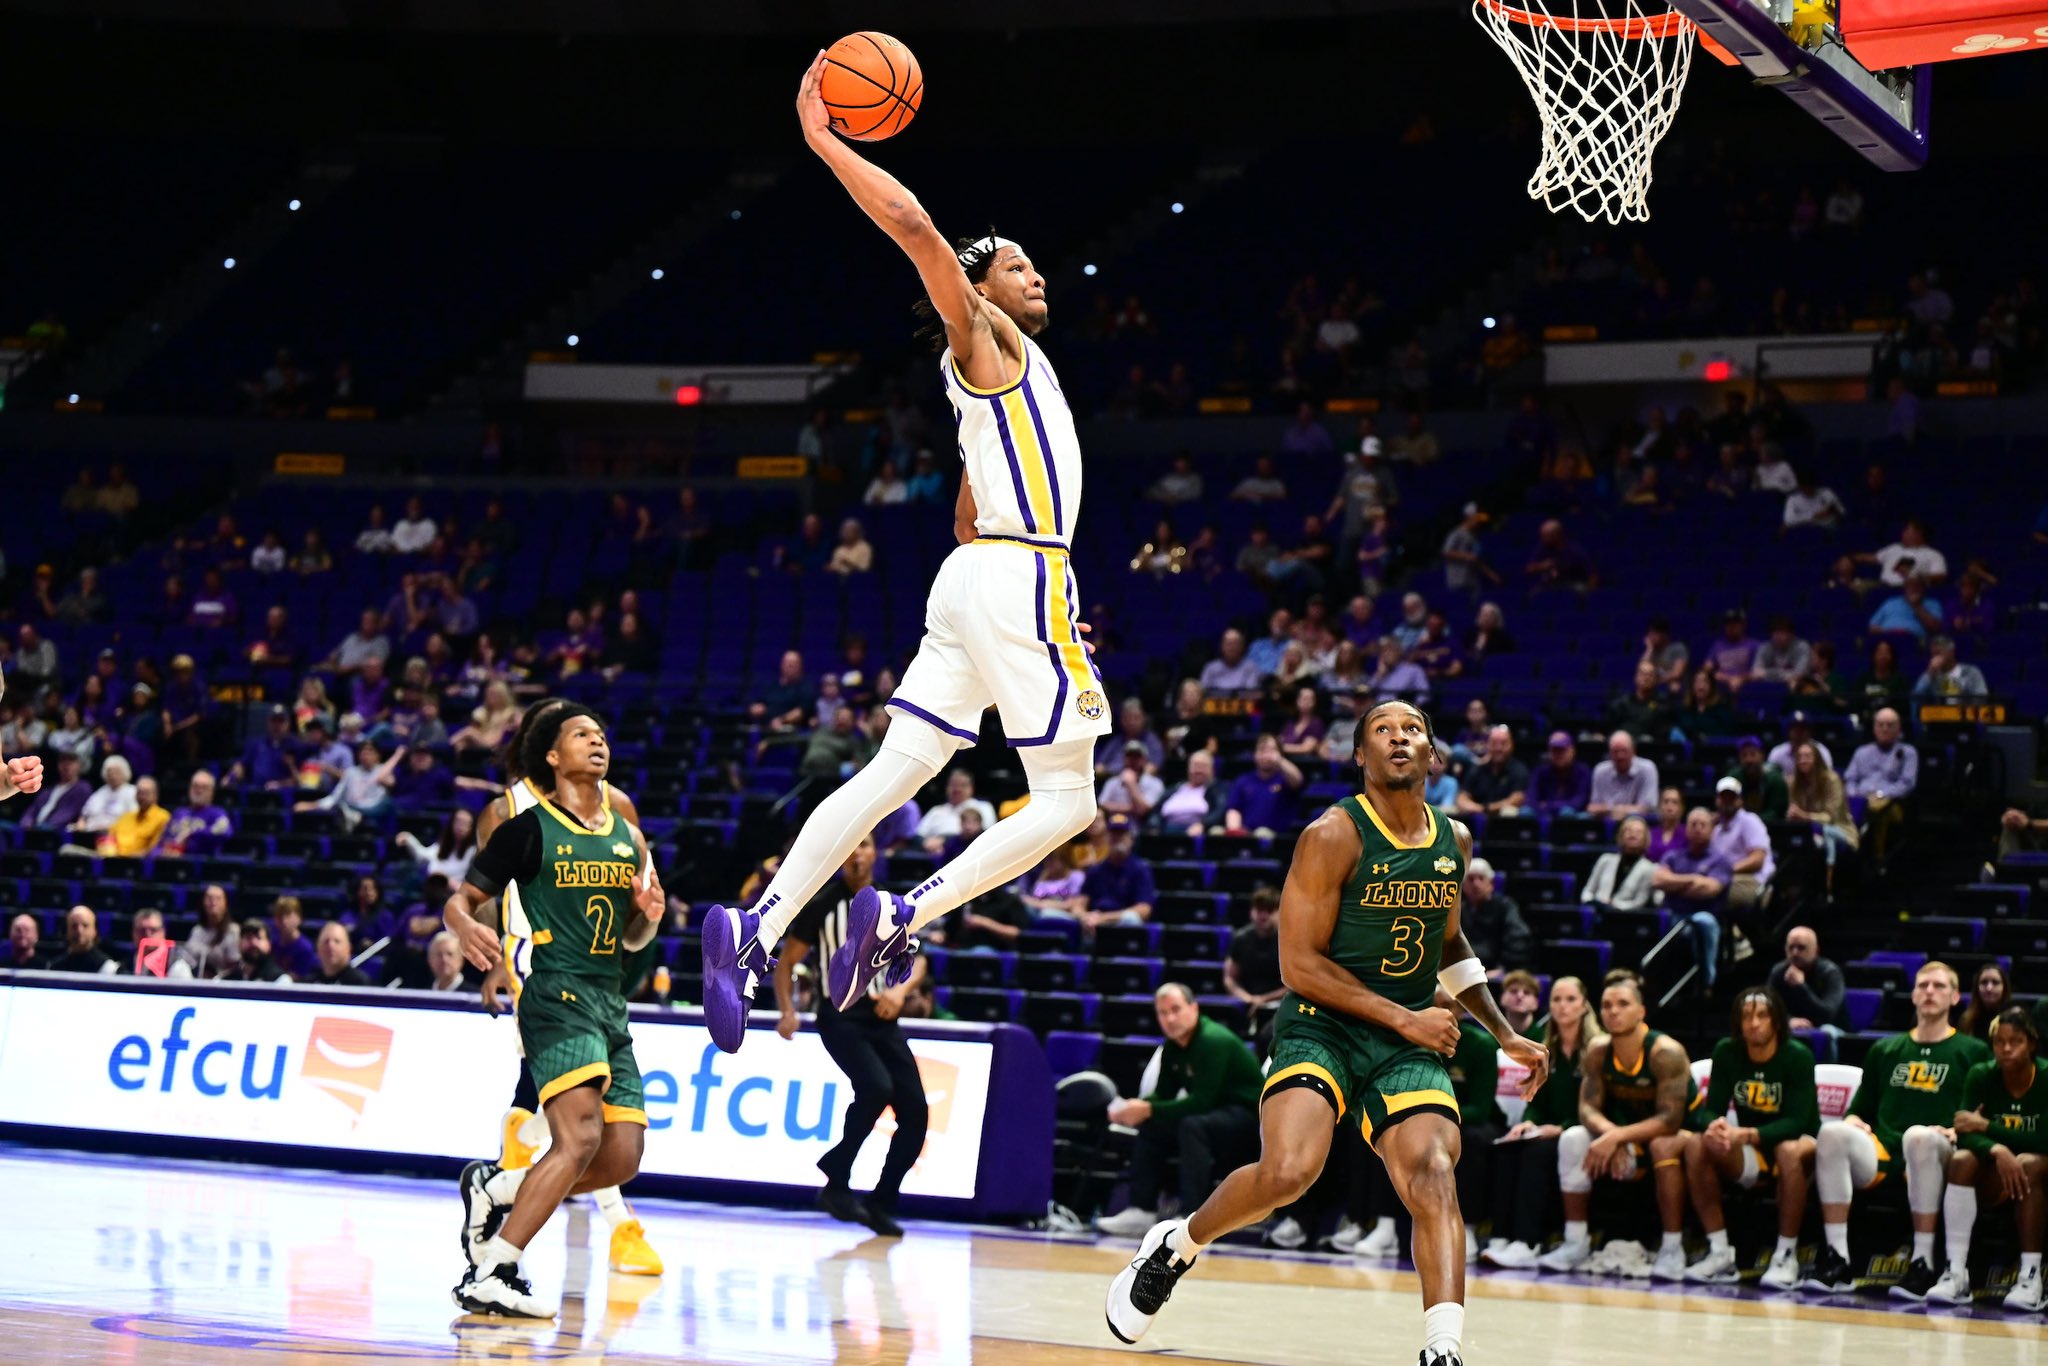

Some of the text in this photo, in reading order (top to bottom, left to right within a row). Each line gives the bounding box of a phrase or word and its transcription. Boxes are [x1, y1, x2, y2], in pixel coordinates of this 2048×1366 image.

[555, 861, 635, 889] LIONS
[1361, 881, 1458, 908] LIONS
[586, 895, 616, 955] 2
[1381, 916, 1425, 977] 3
[108, 1006, 288, 1100] efcu
[641, 1042, 837, 1141] efcu
